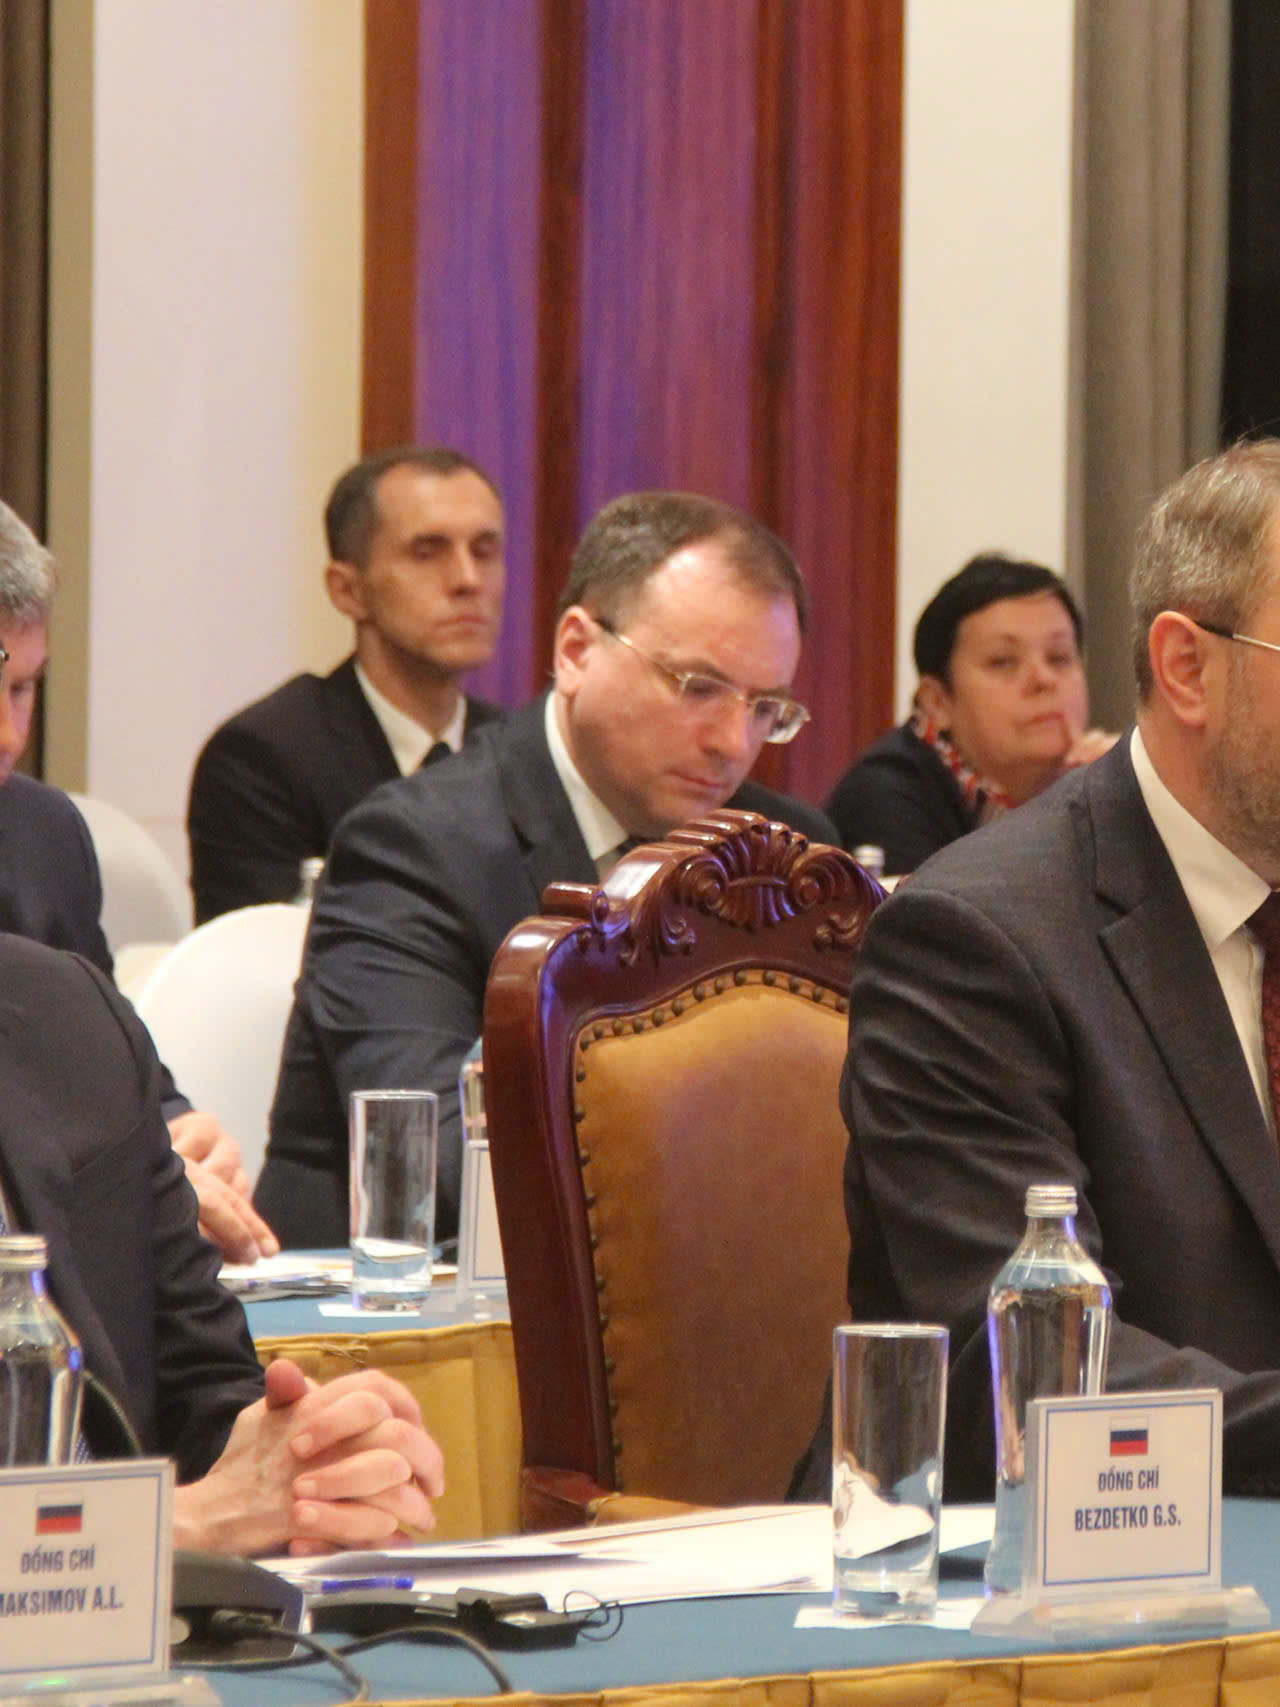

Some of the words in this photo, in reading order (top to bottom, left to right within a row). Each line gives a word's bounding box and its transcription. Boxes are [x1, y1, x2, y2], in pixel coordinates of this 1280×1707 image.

[1138, 1464, 1160, 1490] CHÍ
[1074, 1505, 1148, 1532] BEZDETKO
[1153, 1503, 1182, 1526] G.S.
